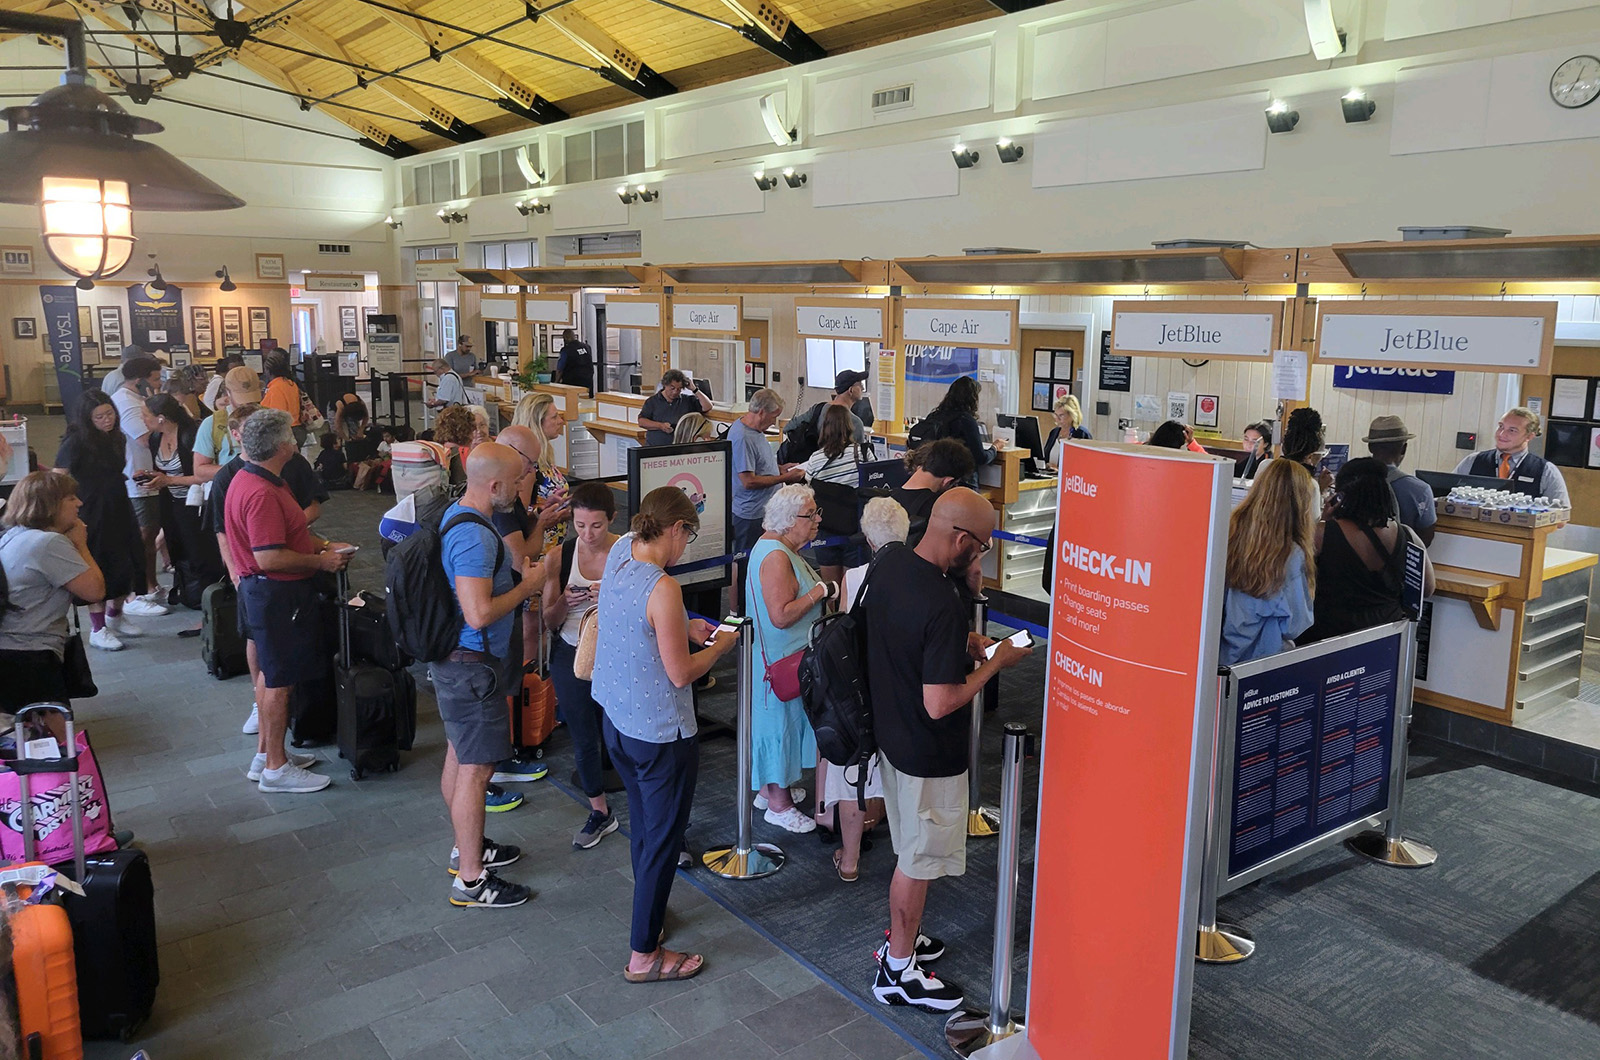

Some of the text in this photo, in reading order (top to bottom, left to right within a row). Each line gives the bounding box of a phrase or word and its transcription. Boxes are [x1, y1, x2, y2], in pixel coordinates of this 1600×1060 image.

[56, 312, 72, 338] TSA
[690, 310, 719, 325] Cape Air
[818, 314, 858, 331] Cape Air
[930, 318, 979, 336] Cape Air
[1158, 324, 1221, 344] JetBlue
[1380, 328, 1469, 352] JetBlue
[58, 341, 73, 363] Pre
[905, 344, 928, 366] ape
[643, 460, 667, 469] THESE
[670, 459, 686, 467] MAY
[1064, 472, 1097, 497] jetBlue
[1062, 540, 1151, 587] CHECK-IN
[1064, 578, 1150, 614] Print boarding passes
[1063, 594, 1107, 621] Change seats
[1078, 621, 1100, 634] more!
[1055, 650, 1102, 688] CHECK-IN
[1104, 702, 1130, 715] abordar
[1243, 698, 1262, 711] ADVICE
[1270, 687, 1299, 702] CUSTOMERS
[482, 848, 498, 862] N
[478, 888, 499, 904] N
